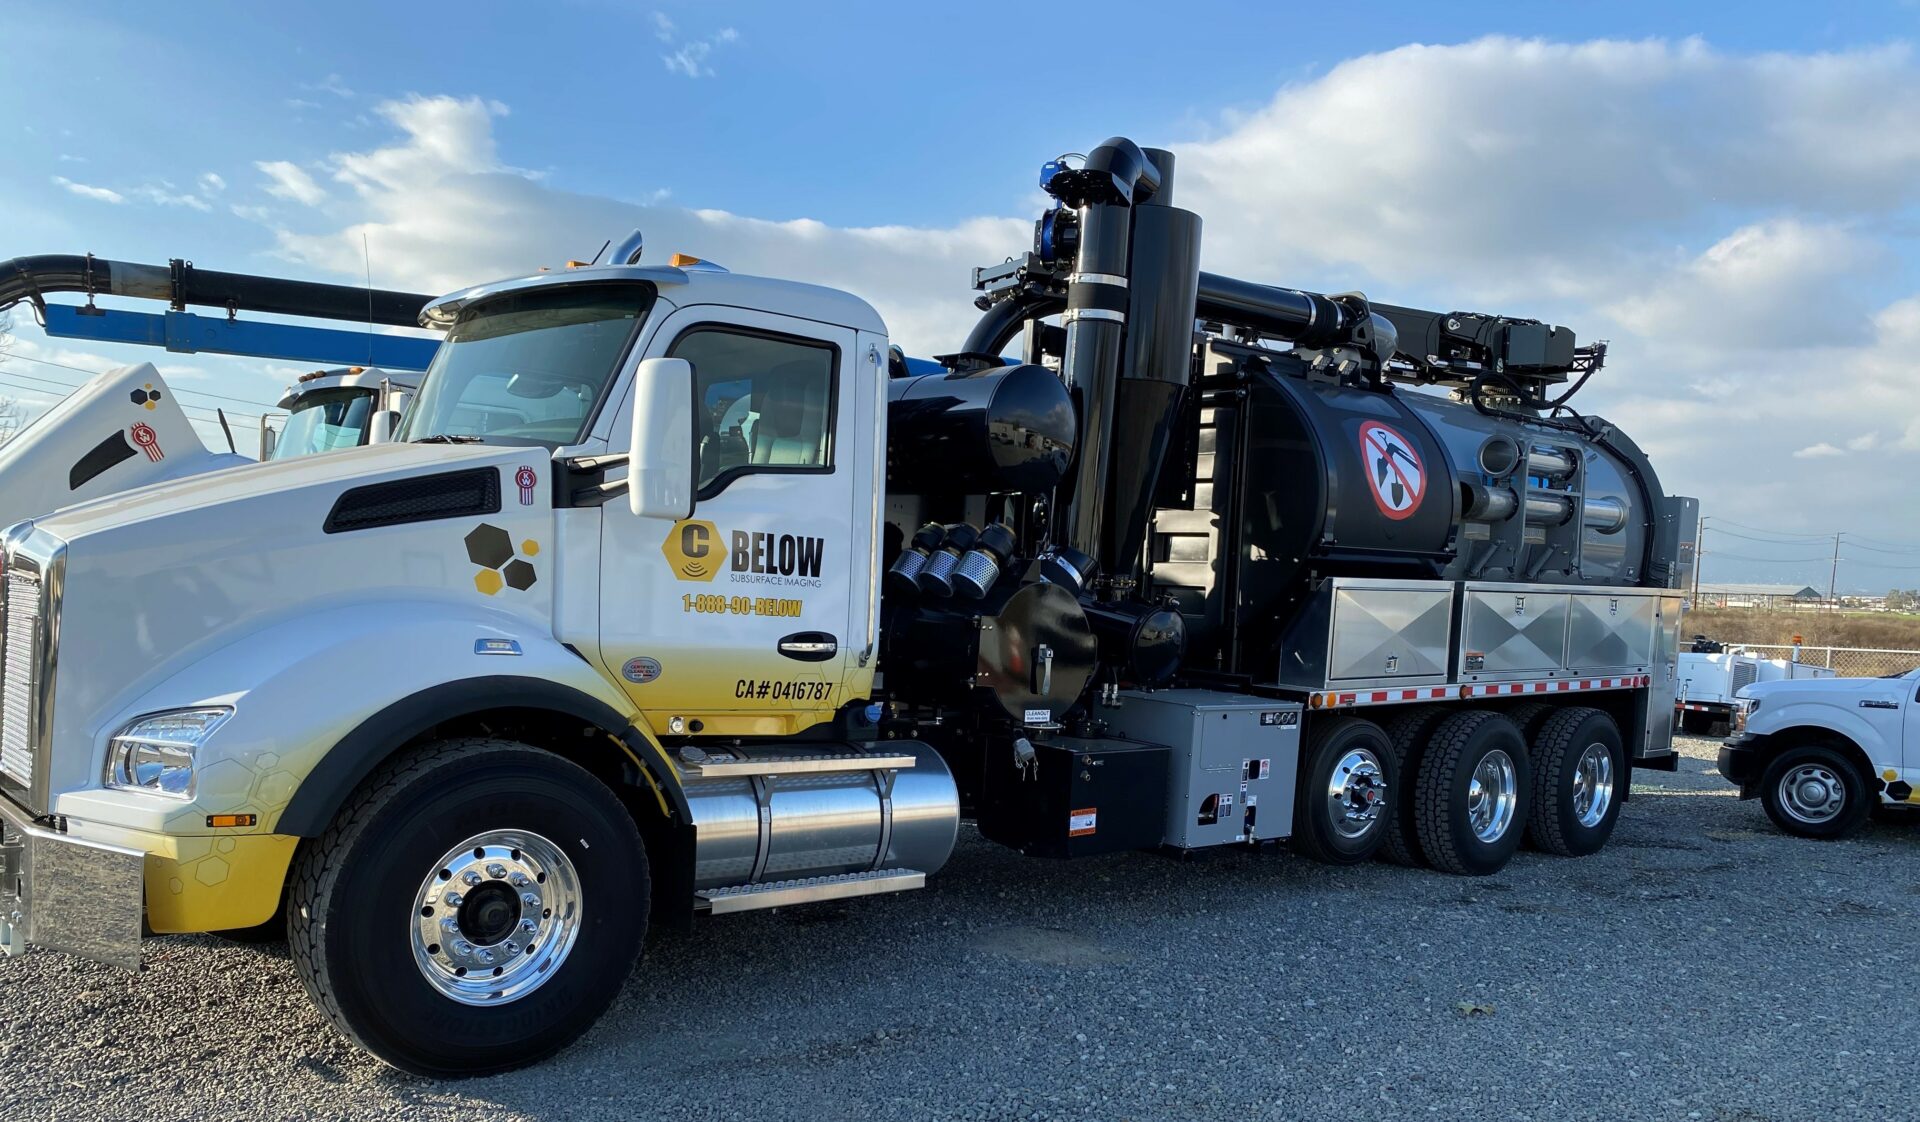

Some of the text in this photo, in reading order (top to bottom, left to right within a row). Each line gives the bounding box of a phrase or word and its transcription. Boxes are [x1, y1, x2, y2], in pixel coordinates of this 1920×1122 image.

[682, 524, 824, 578] C BELOW
[730, 573, 822, 588] SUBSURFACE IMAGING
[682, 594, 802, 617] 1-888-90-BELOW
